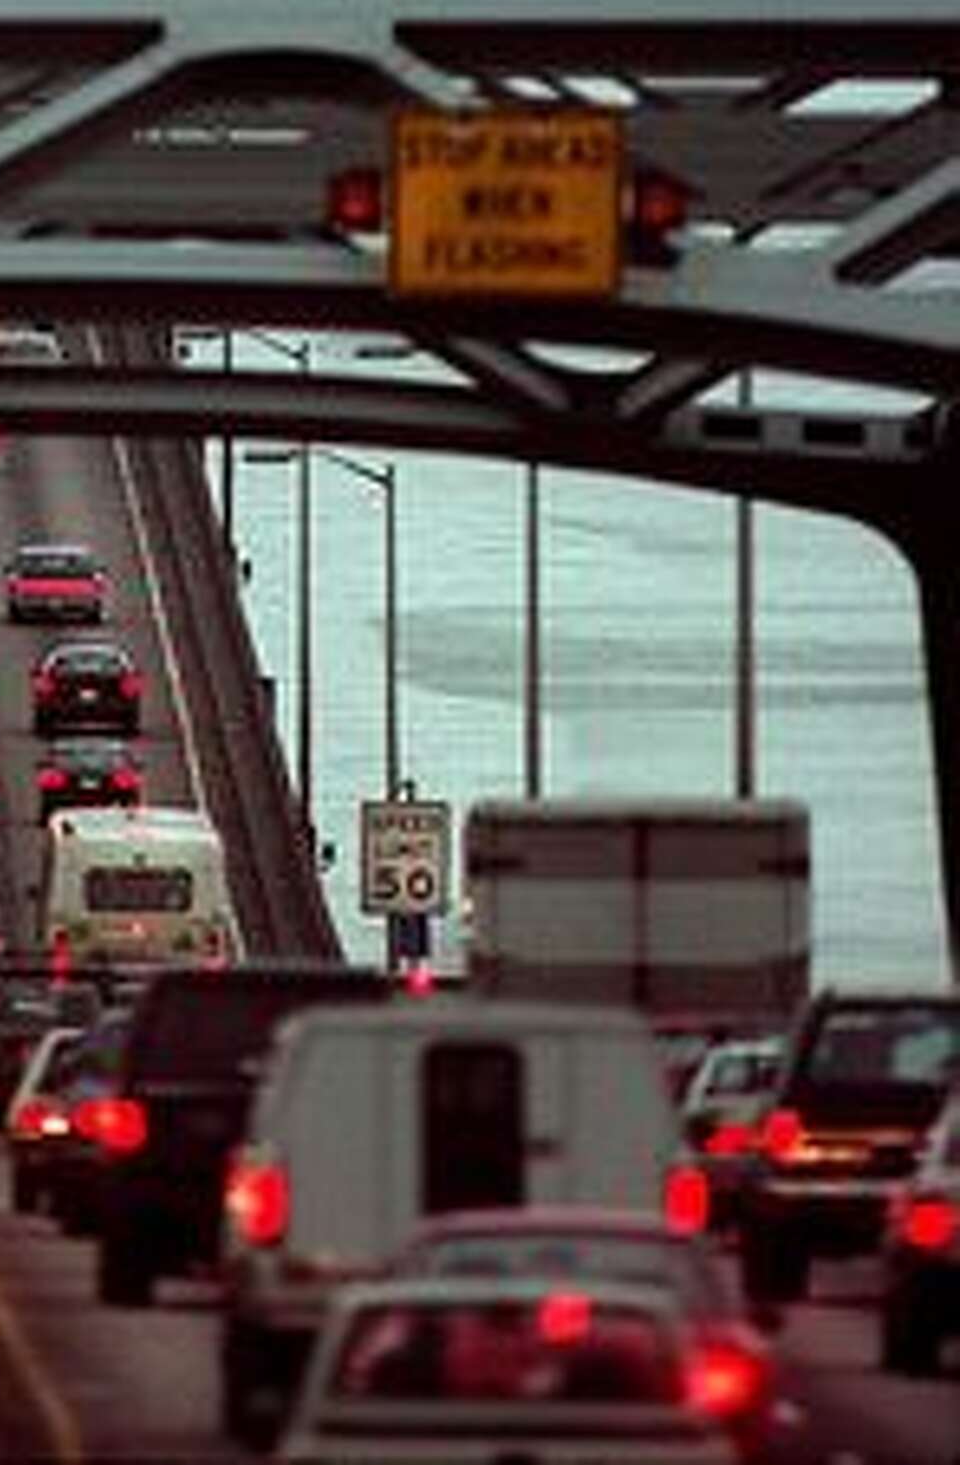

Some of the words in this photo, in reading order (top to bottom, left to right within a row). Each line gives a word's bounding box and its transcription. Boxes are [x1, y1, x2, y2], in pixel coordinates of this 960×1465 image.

[399, 130, 481, 169] STOP
[500, 130, 609, 169] AHEAD
[462, 187, 553, 219] WHEN
[424, 236, 594, 272] FLASHING
[371, 866, 434, 900] 50
